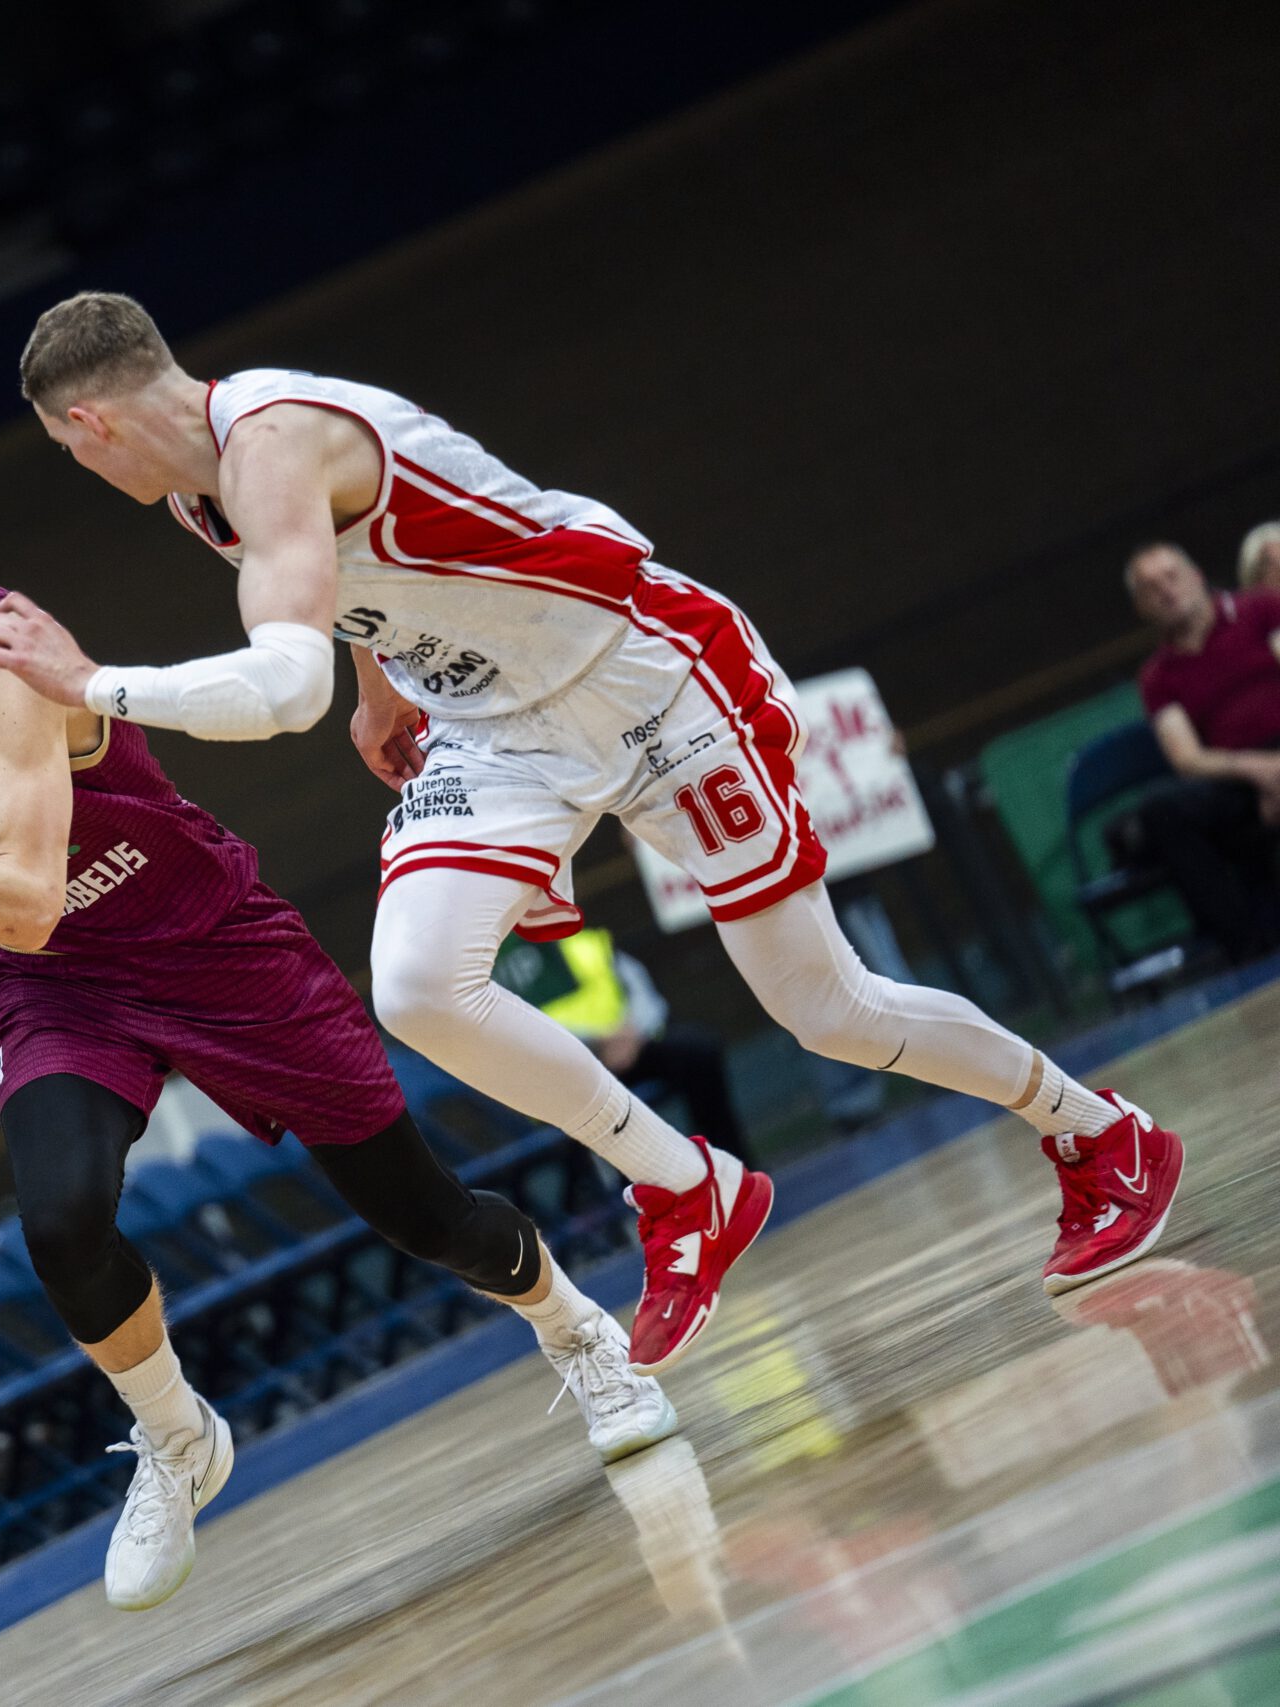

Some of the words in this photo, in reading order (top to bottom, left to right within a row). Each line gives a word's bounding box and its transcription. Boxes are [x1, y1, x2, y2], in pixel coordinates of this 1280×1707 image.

[416, 776, 462, 793] Utenos
[405, 793, 468, 814] UTENOS
[408, 806, 475, 821] REKYBA
[673, 763, 767, 857] 16
[61, 841, 149, 917] ABELIS
